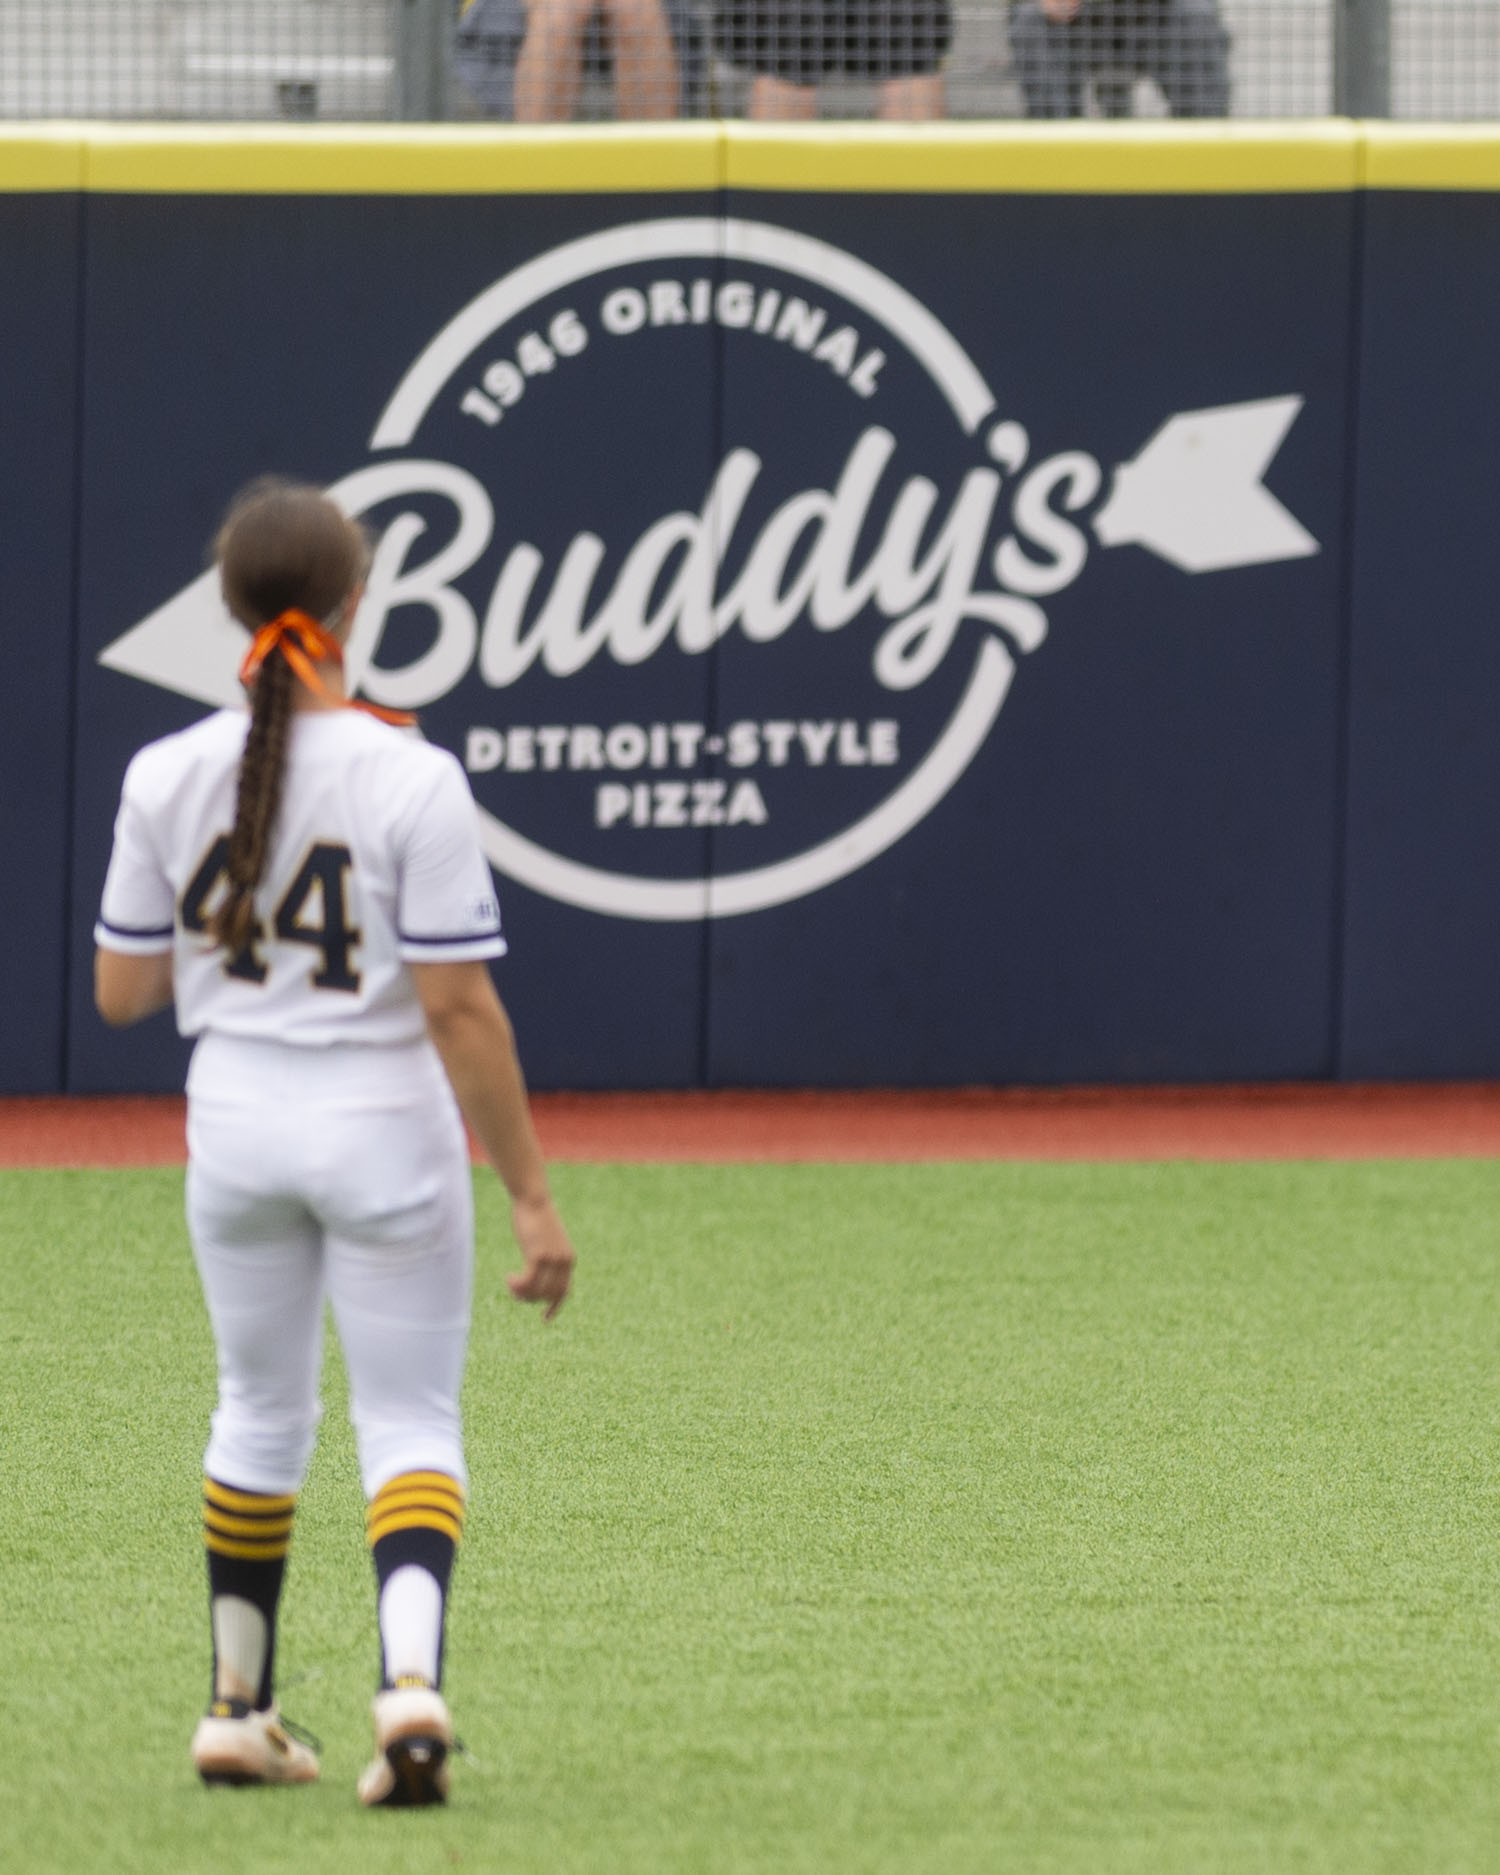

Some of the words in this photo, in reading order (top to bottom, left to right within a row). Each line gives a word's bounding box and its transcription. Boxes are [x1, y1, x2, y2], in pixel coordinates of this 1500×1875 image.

[461, 309, 588, 427] 1946
[601, 279, 886, 399] ORIGINAL
[322, 419, 1103, 708] Buddy's
[466, 720, 898, 772] DETROIT-STYLE
[597, 779, 768, 827] PIZZA
[180, 833, 362, 994] 44
